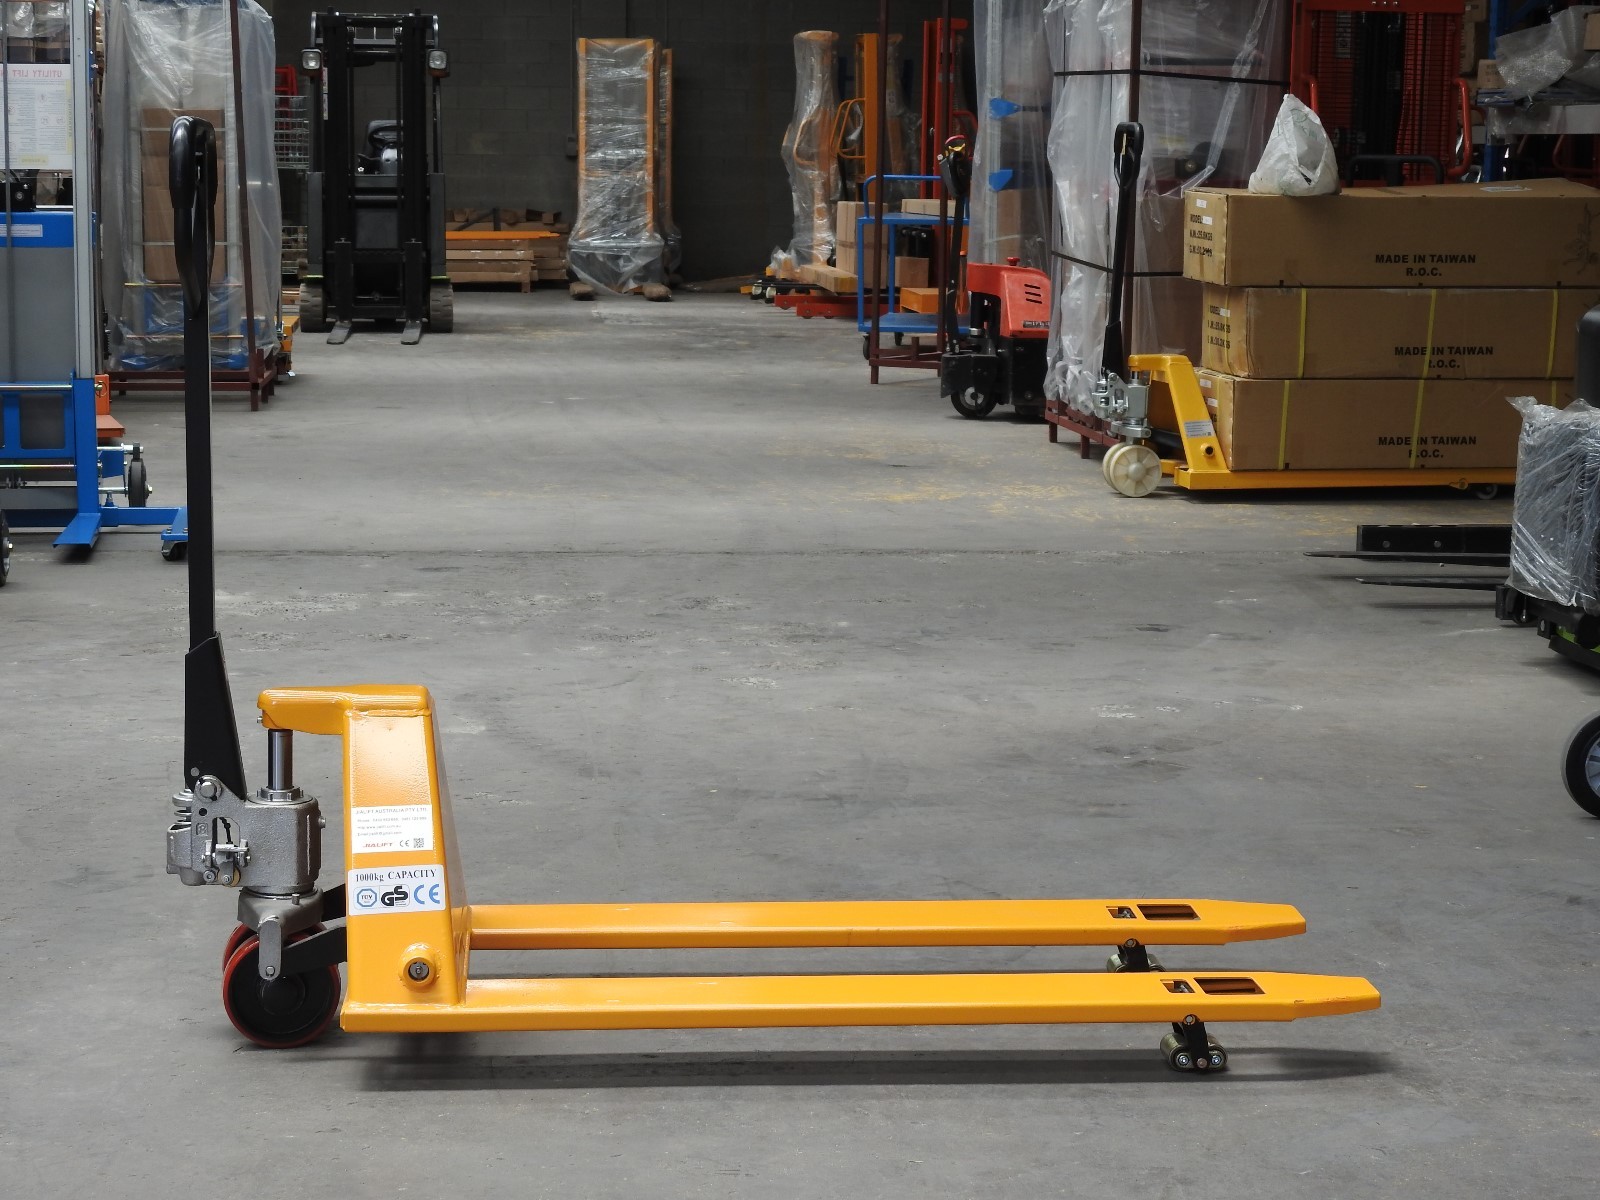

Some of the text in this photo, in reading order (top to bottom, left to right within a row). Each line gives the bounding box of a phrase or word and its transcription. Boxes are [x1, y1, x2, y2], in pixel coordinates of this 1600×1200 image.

[1375, 254, 1476, 263] MADE IN TAIWAN
[1406, 267, 1442, 276] R.O.C.
[1395, 346, 1493, 356] MADE IN TAIWAN
[1378, 436, 1411, 446] MADE
[1430, 436, 1477, 445] TAIWAN
[355, 868, 437, 882] 1000kg CAPACITY
